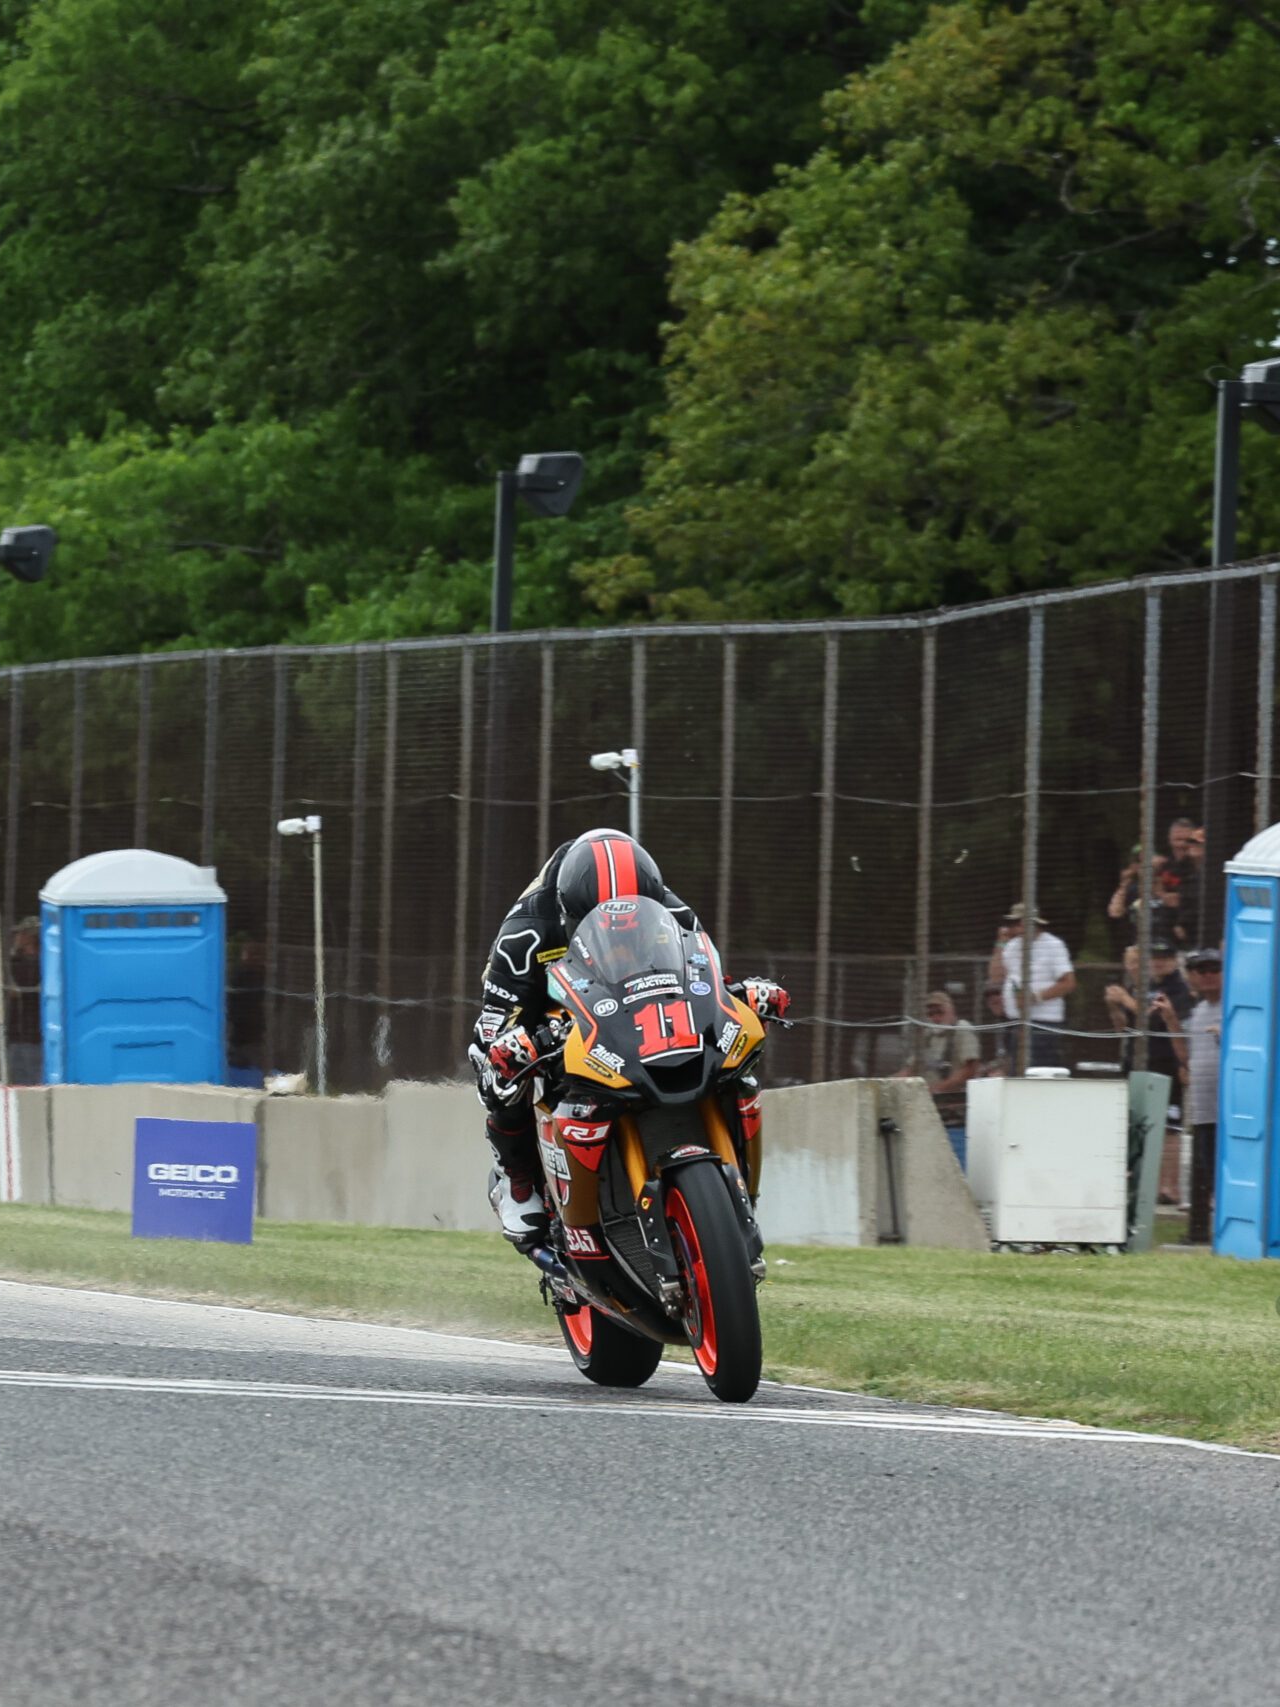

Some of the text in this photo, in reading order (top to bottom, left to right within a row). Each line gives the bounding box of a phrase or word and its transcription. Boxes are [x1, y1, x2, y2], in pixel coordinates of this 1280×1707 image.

[603, 902, 634, 913] HJC
[637, 978, 679, 991] AUCTIONS
[633, 1000, 699, 1057] 11
[588, 1043, 626, 1074] Attack
[562, 1123, 610, 1141] R1
[147, 1162, 239, 1183] GEICO
[158, 1187, 228, 1200] MOTORCYCLE
